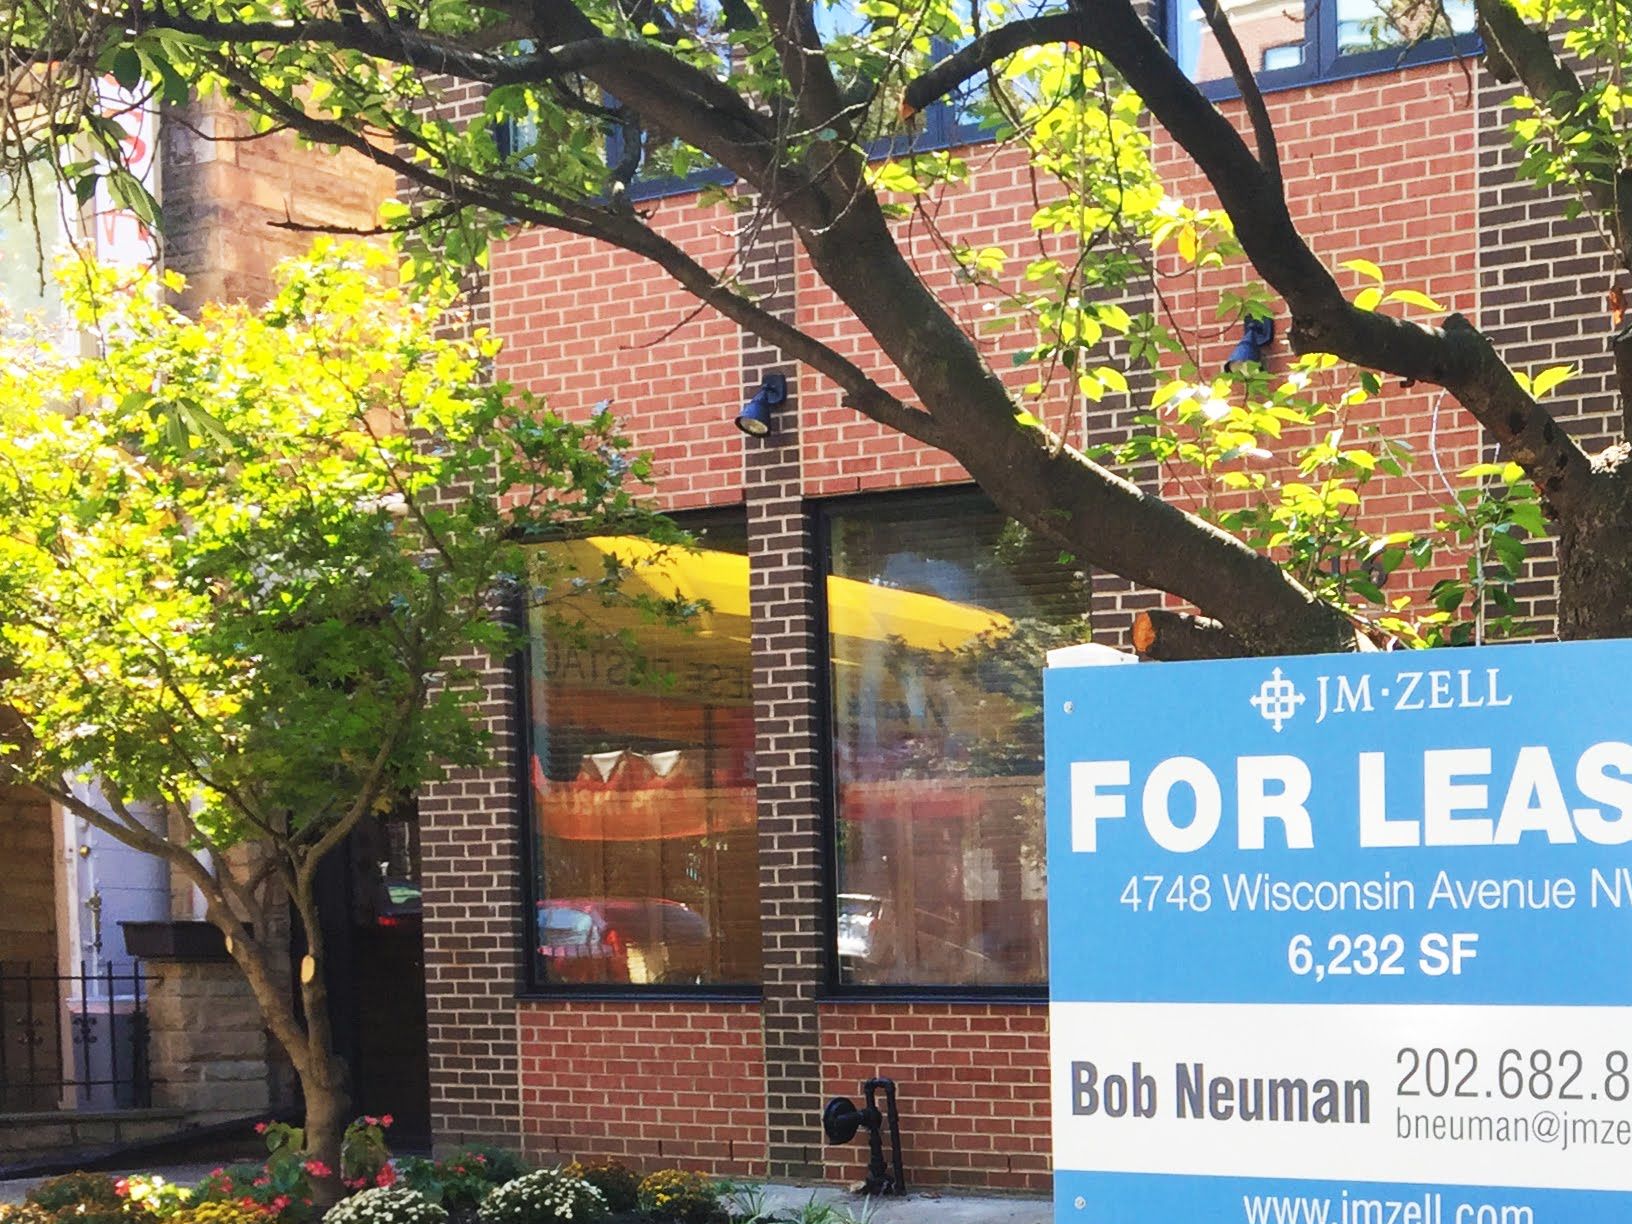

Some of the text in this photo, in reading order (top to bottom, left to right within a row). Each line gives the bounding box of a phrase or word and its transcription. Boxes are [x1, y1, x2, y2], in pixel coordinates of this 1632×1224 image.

[1070, 755, 1314, 852] FOR
[1120, 875, 1211, 912] 4748
[1223, 872, 1414, 912] Wisconsin
[1428, 871, 1575, 910] Avenue
[1288, 933, 1479, 981] 6,232 SF
[1071, 1060, 1370, 1124] Bob Neuman
